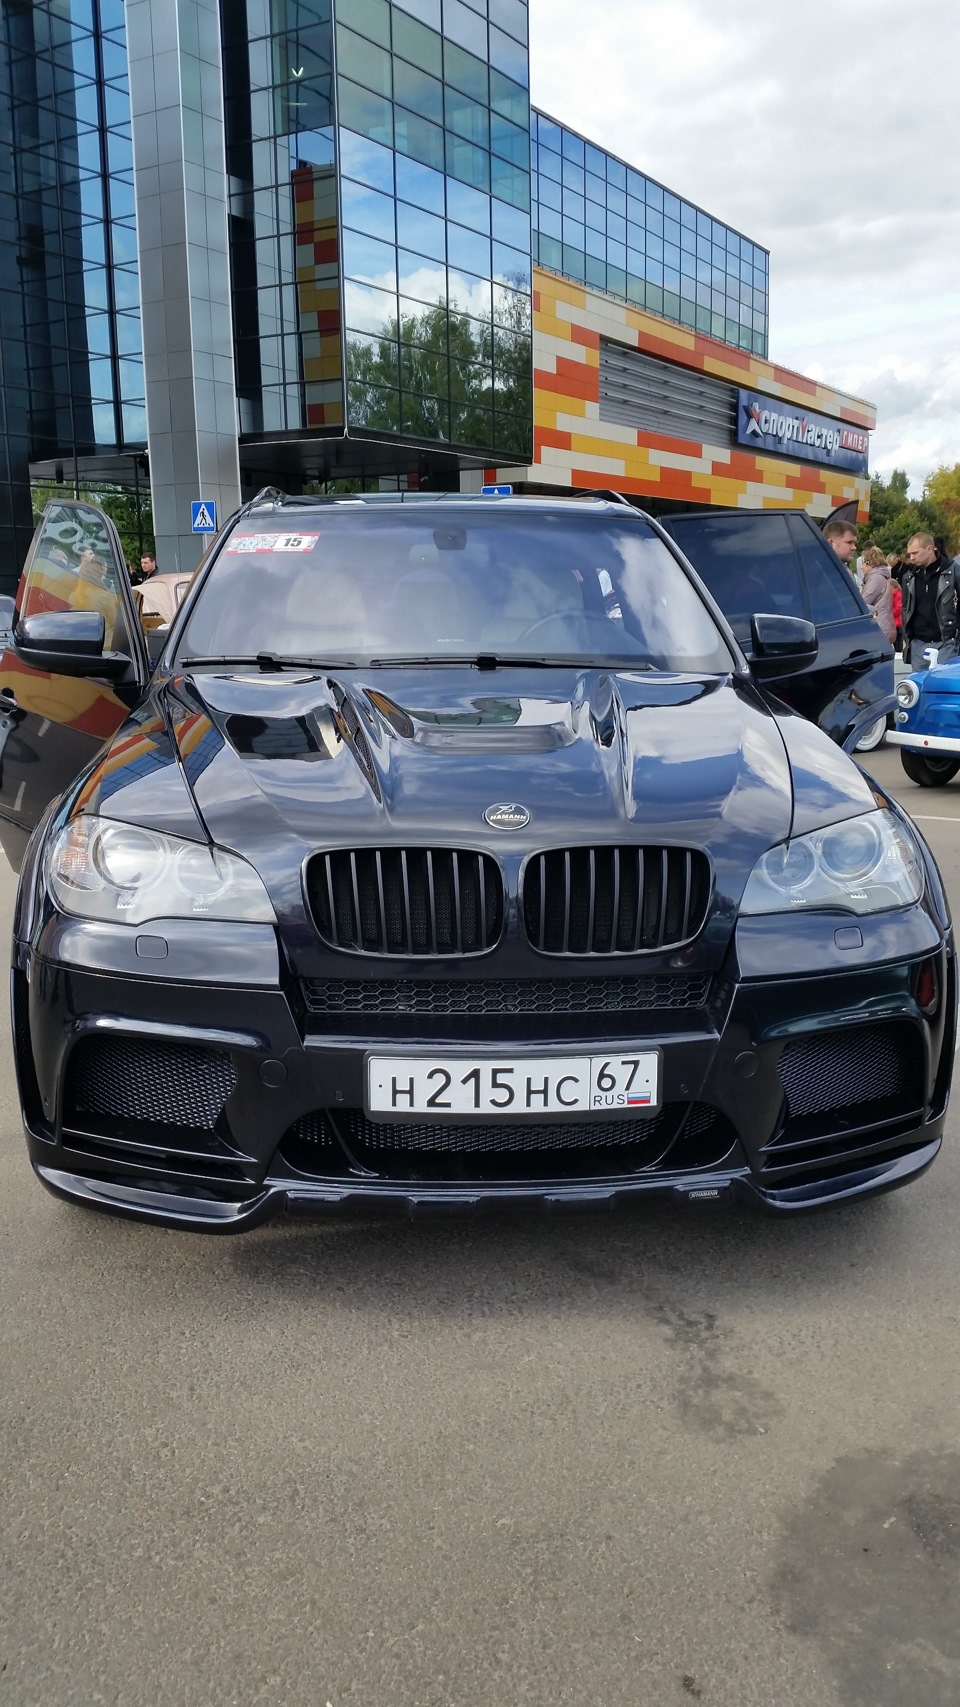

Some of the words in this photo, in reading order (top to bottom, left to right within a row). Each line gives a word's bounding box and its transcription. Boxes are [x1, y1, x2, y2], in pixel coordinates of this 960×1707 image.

[284, 537, 303, 547] 15
[596, 1059, 640, 1092] 67
[593, 1094, 626, 1106] RUS
